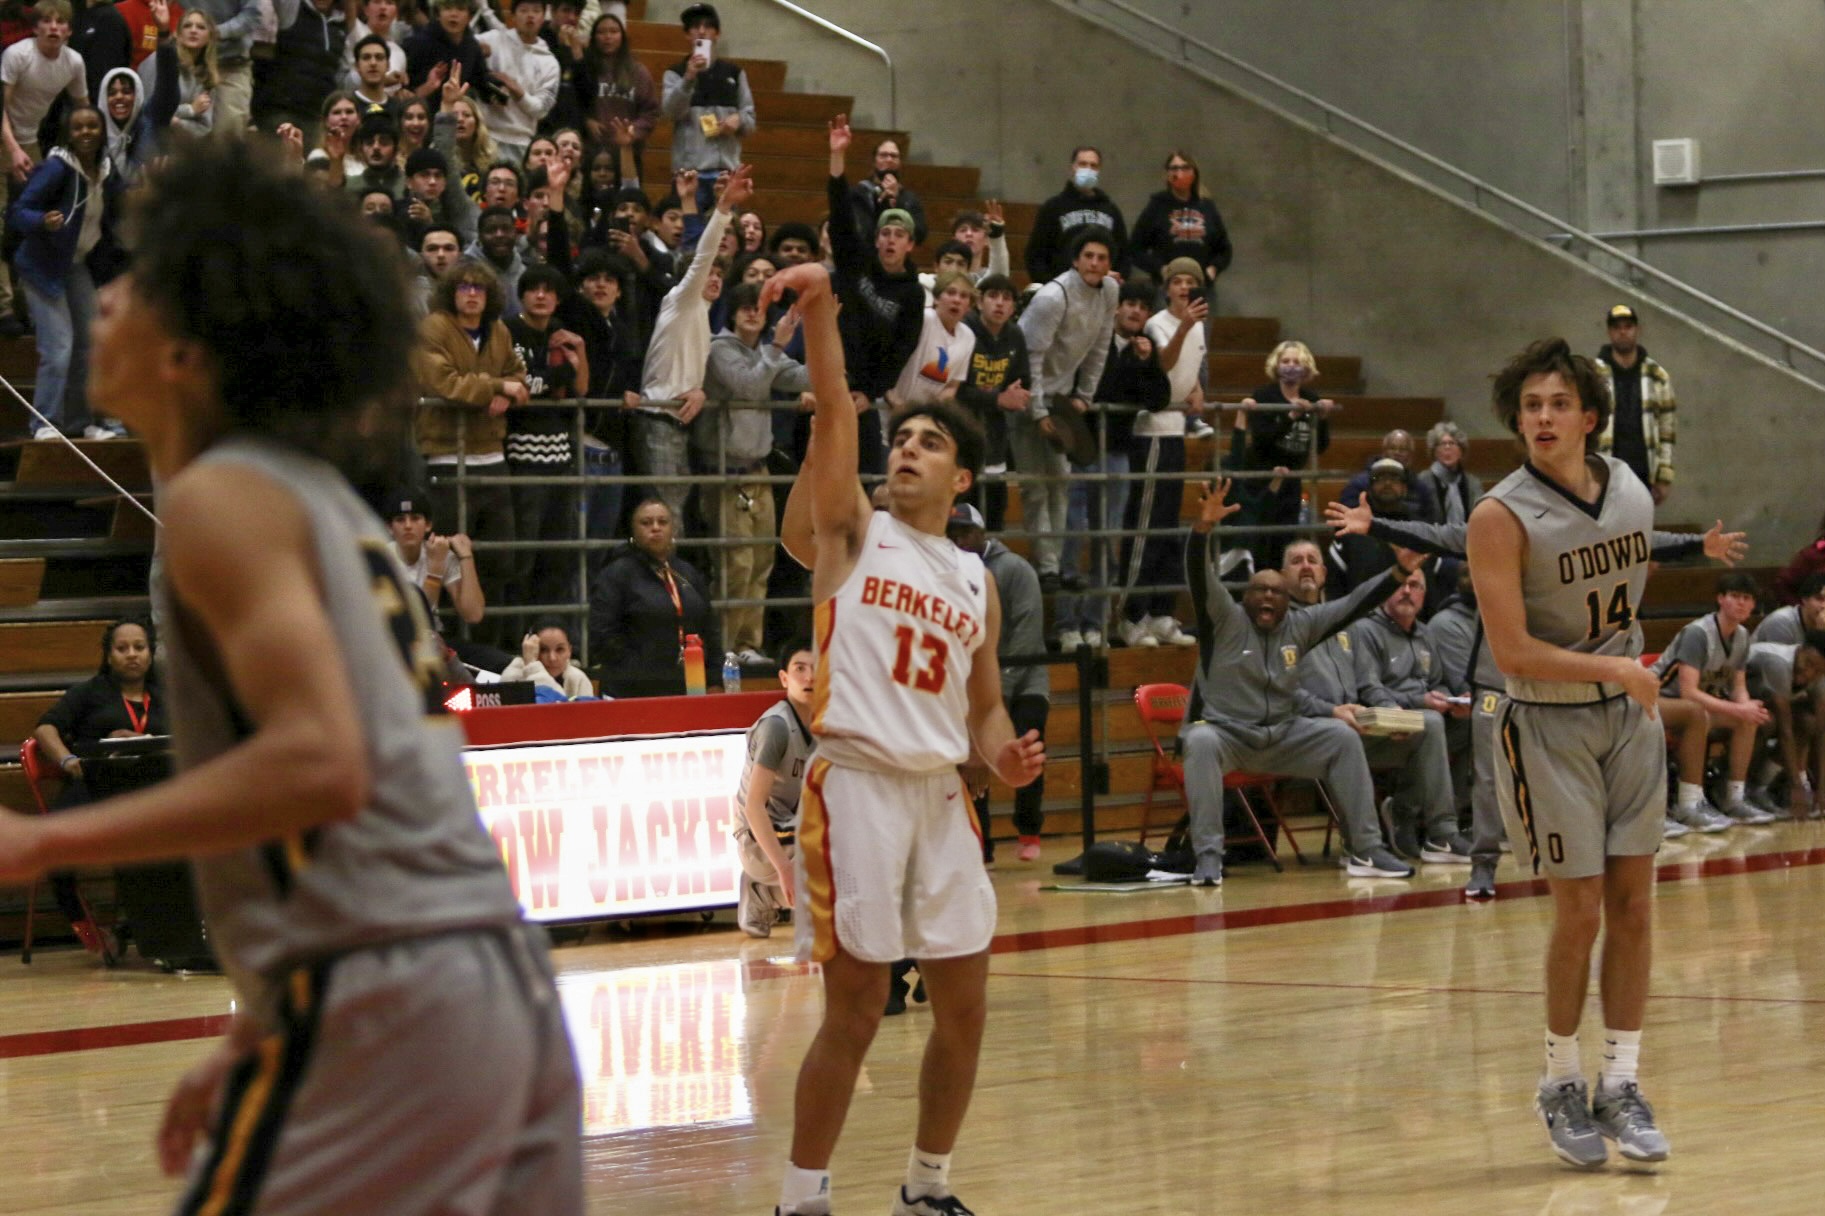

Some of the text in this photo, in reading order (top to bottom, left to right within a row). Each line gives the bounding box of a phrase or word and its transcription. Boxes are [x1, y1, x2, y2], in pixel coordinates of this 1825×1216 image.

[976, 371, 1004, 386] CUP
[1558, 531, 1648, 585] O'DOWD
[861, 576, 979, 647] BERKELEY
[1586, 580, 1634, 641] 14
[892, 624, 949, 695] 13
[476, 693, 502, 708] POSS
[641, 749, 724, 795] HIGH
[588, 795, 738, 904] JACKE
